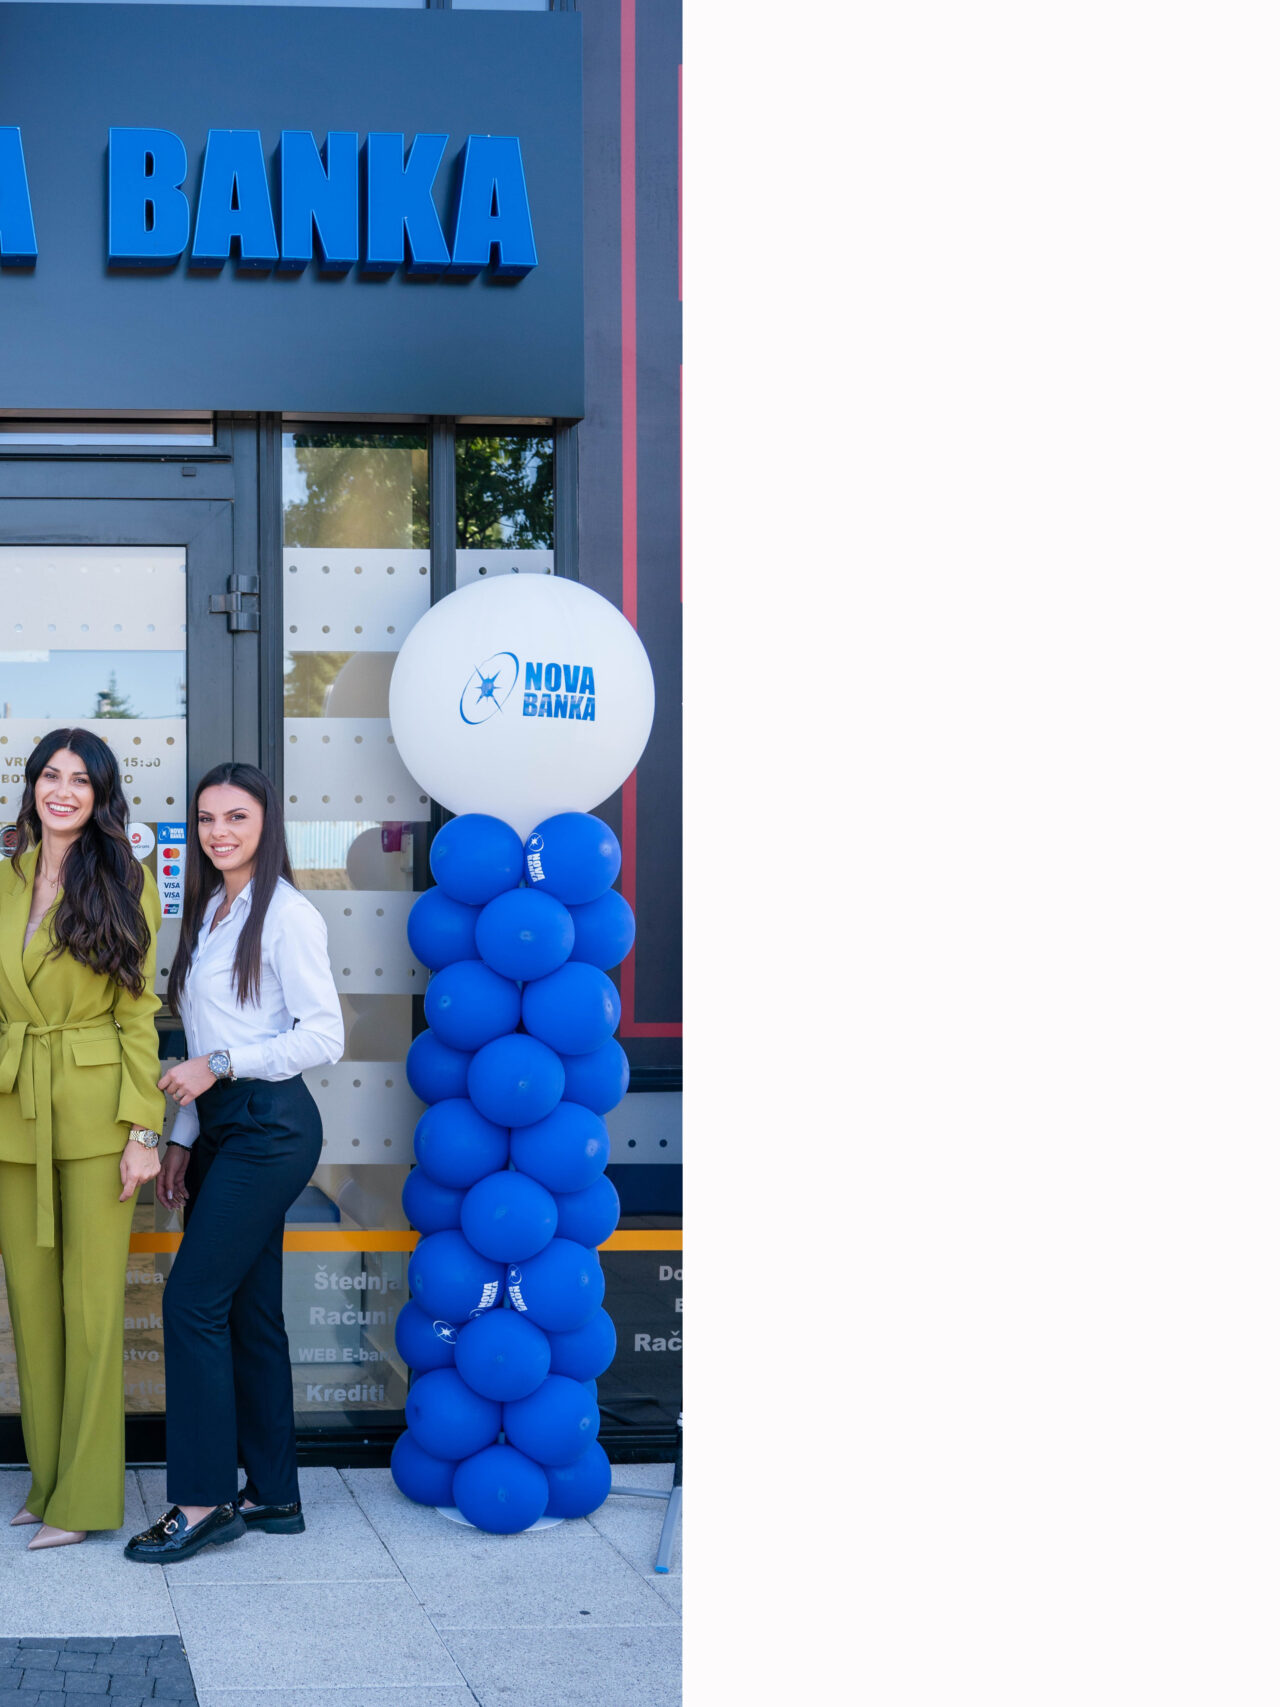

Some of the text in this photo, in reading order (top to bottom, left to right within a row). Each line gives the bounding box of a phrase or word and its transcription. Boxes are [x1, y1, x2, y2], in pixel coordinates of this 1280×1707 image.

[106, 127, 539, 276] BANKA
[524, 661, 596, 696] NOVA
[522, 691, 596, 722] BANKA
[532, 853, 546, 881] NOVA
[313, 1264, 404, 1295] Štednja
[477, 1282, 493, 1308] NOVA
[512, 1285, 528, 1311] NOVA
[309, 1304, 395, 1326] Računi
[298, 1348, 337, 1362] WEB
[306, 1384, 385, 1403] Krediti
